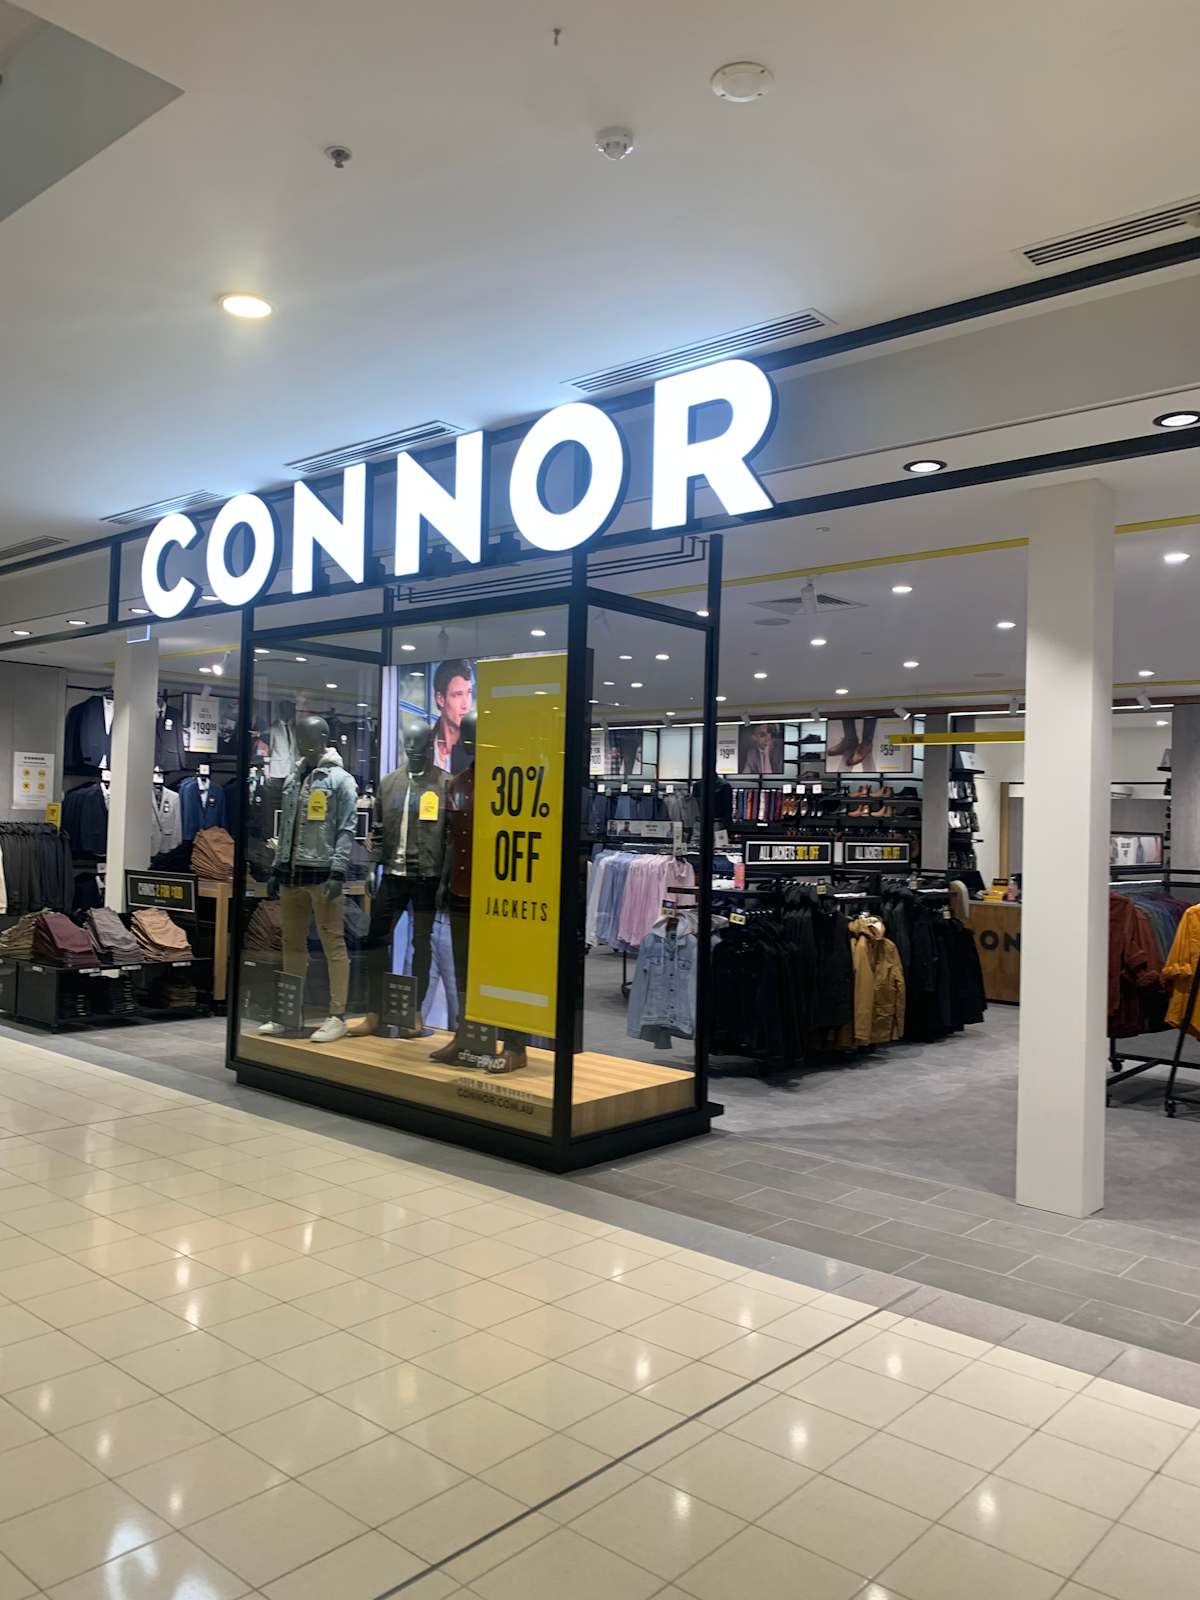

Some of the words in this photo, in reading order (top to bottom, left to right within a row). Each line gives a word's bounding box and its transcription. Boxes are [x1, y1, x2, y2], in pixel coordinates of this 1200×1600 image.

[141, 359, 774, 618] CONNOR
[490, 766, 550, 818] 30%
[495, 830, 542, 883] OFF
[485, 897, 548, 922] JACKETS
